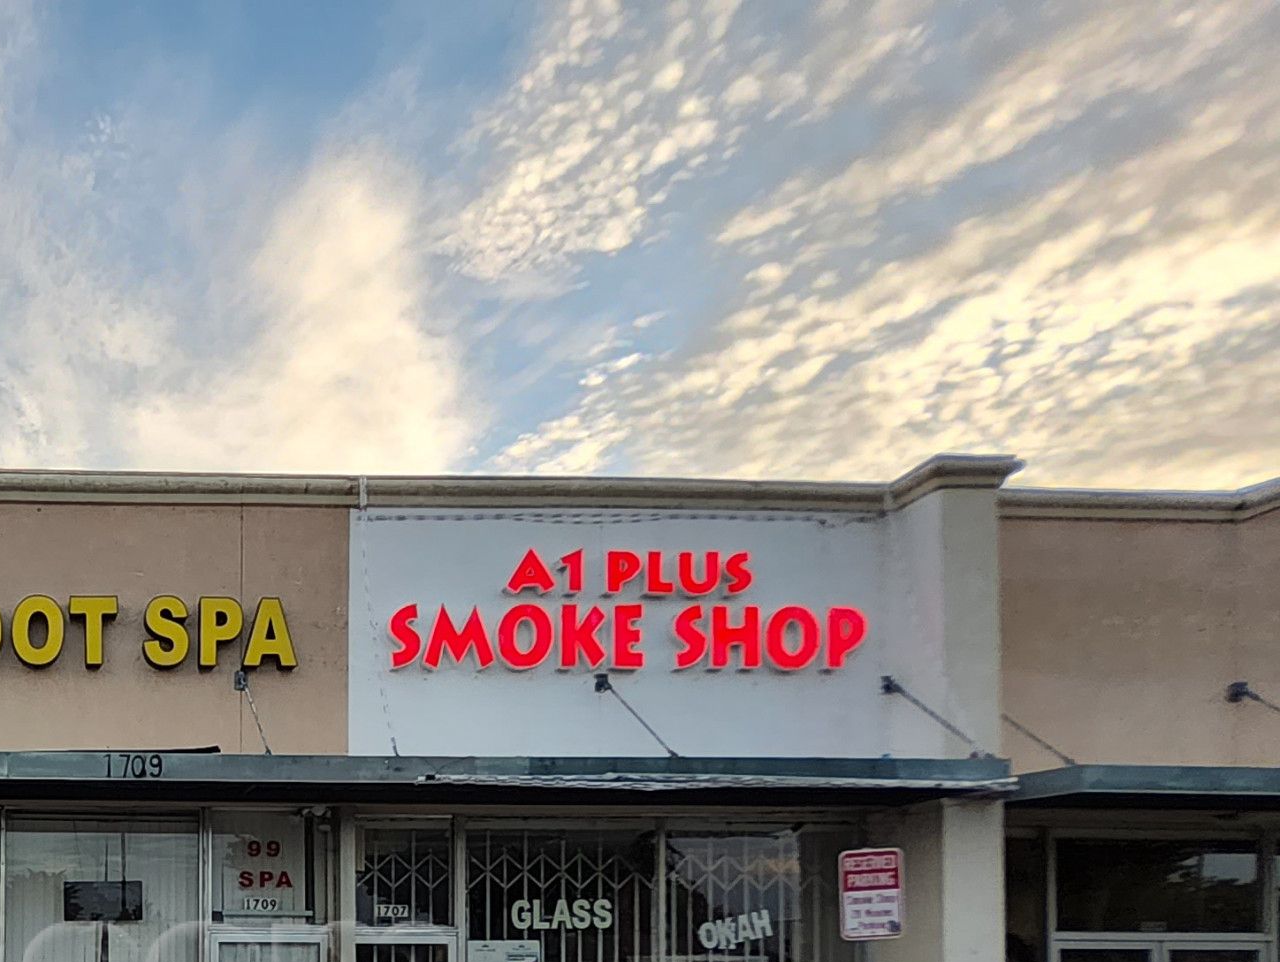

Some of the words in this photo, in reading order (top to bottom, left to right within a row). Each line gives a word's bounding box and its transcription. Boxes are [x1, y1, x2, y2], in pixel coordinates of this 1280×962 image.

[505, 548, 584, 594] A1
[606, 550, 754, 594] PLUS
[142, 595, 298, 669] SPA
[389, 603, 645, 669] SMOKE
[673, 605, 867, 670] SHOP
[103, 753, 163, 778] 1709
[247, 840, 280, 858] 99
[238, 871, 293, 888] SPA
[245, 899, 277, 911] 1709
[376, 904, 406, 917] 1707
[511, 899, 612, 930] GLASS
